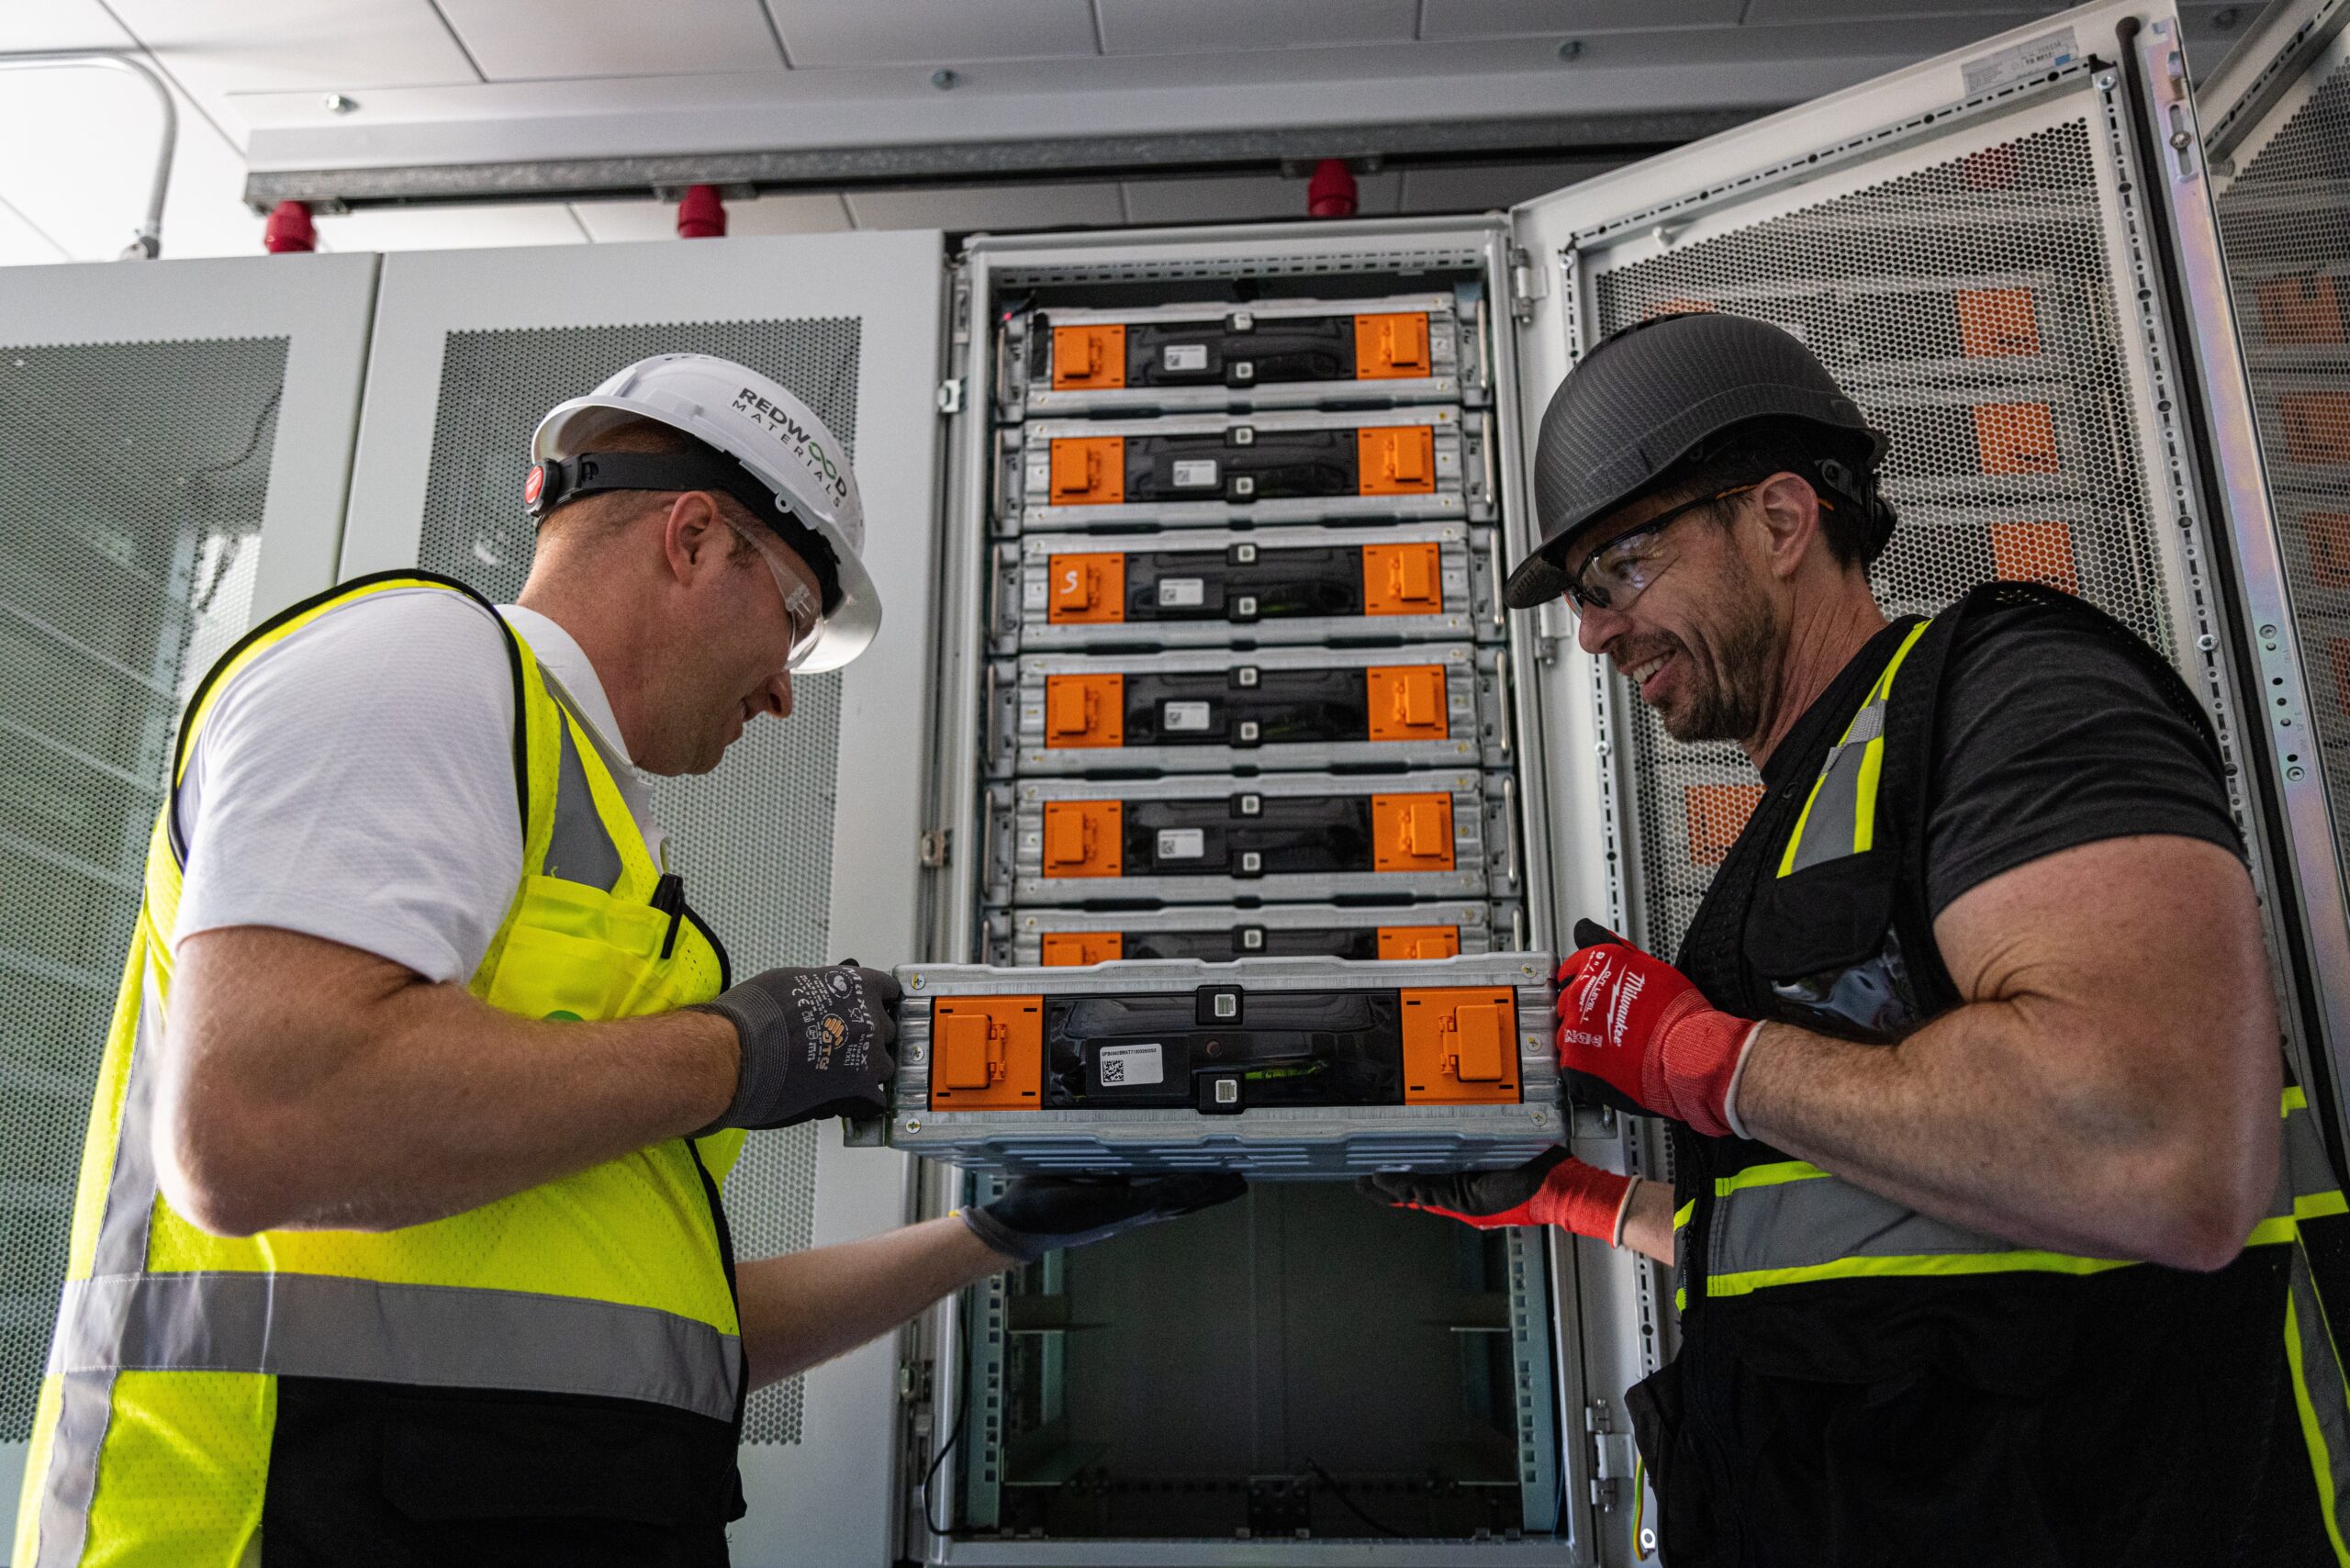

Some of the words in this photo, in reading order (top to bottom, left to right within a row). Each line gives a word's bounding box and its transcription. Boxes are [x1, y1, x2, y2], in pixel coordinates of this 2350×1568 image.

[732, 399, 841, 508] MATERIALS
[737, 386, 847, 498] REDWOOD
[1585, 987, 1602, 1013] LEVEL
[1598, 970, 1612, 987] CUT
[1613, 970, 1646, 1045] Milwaukee
